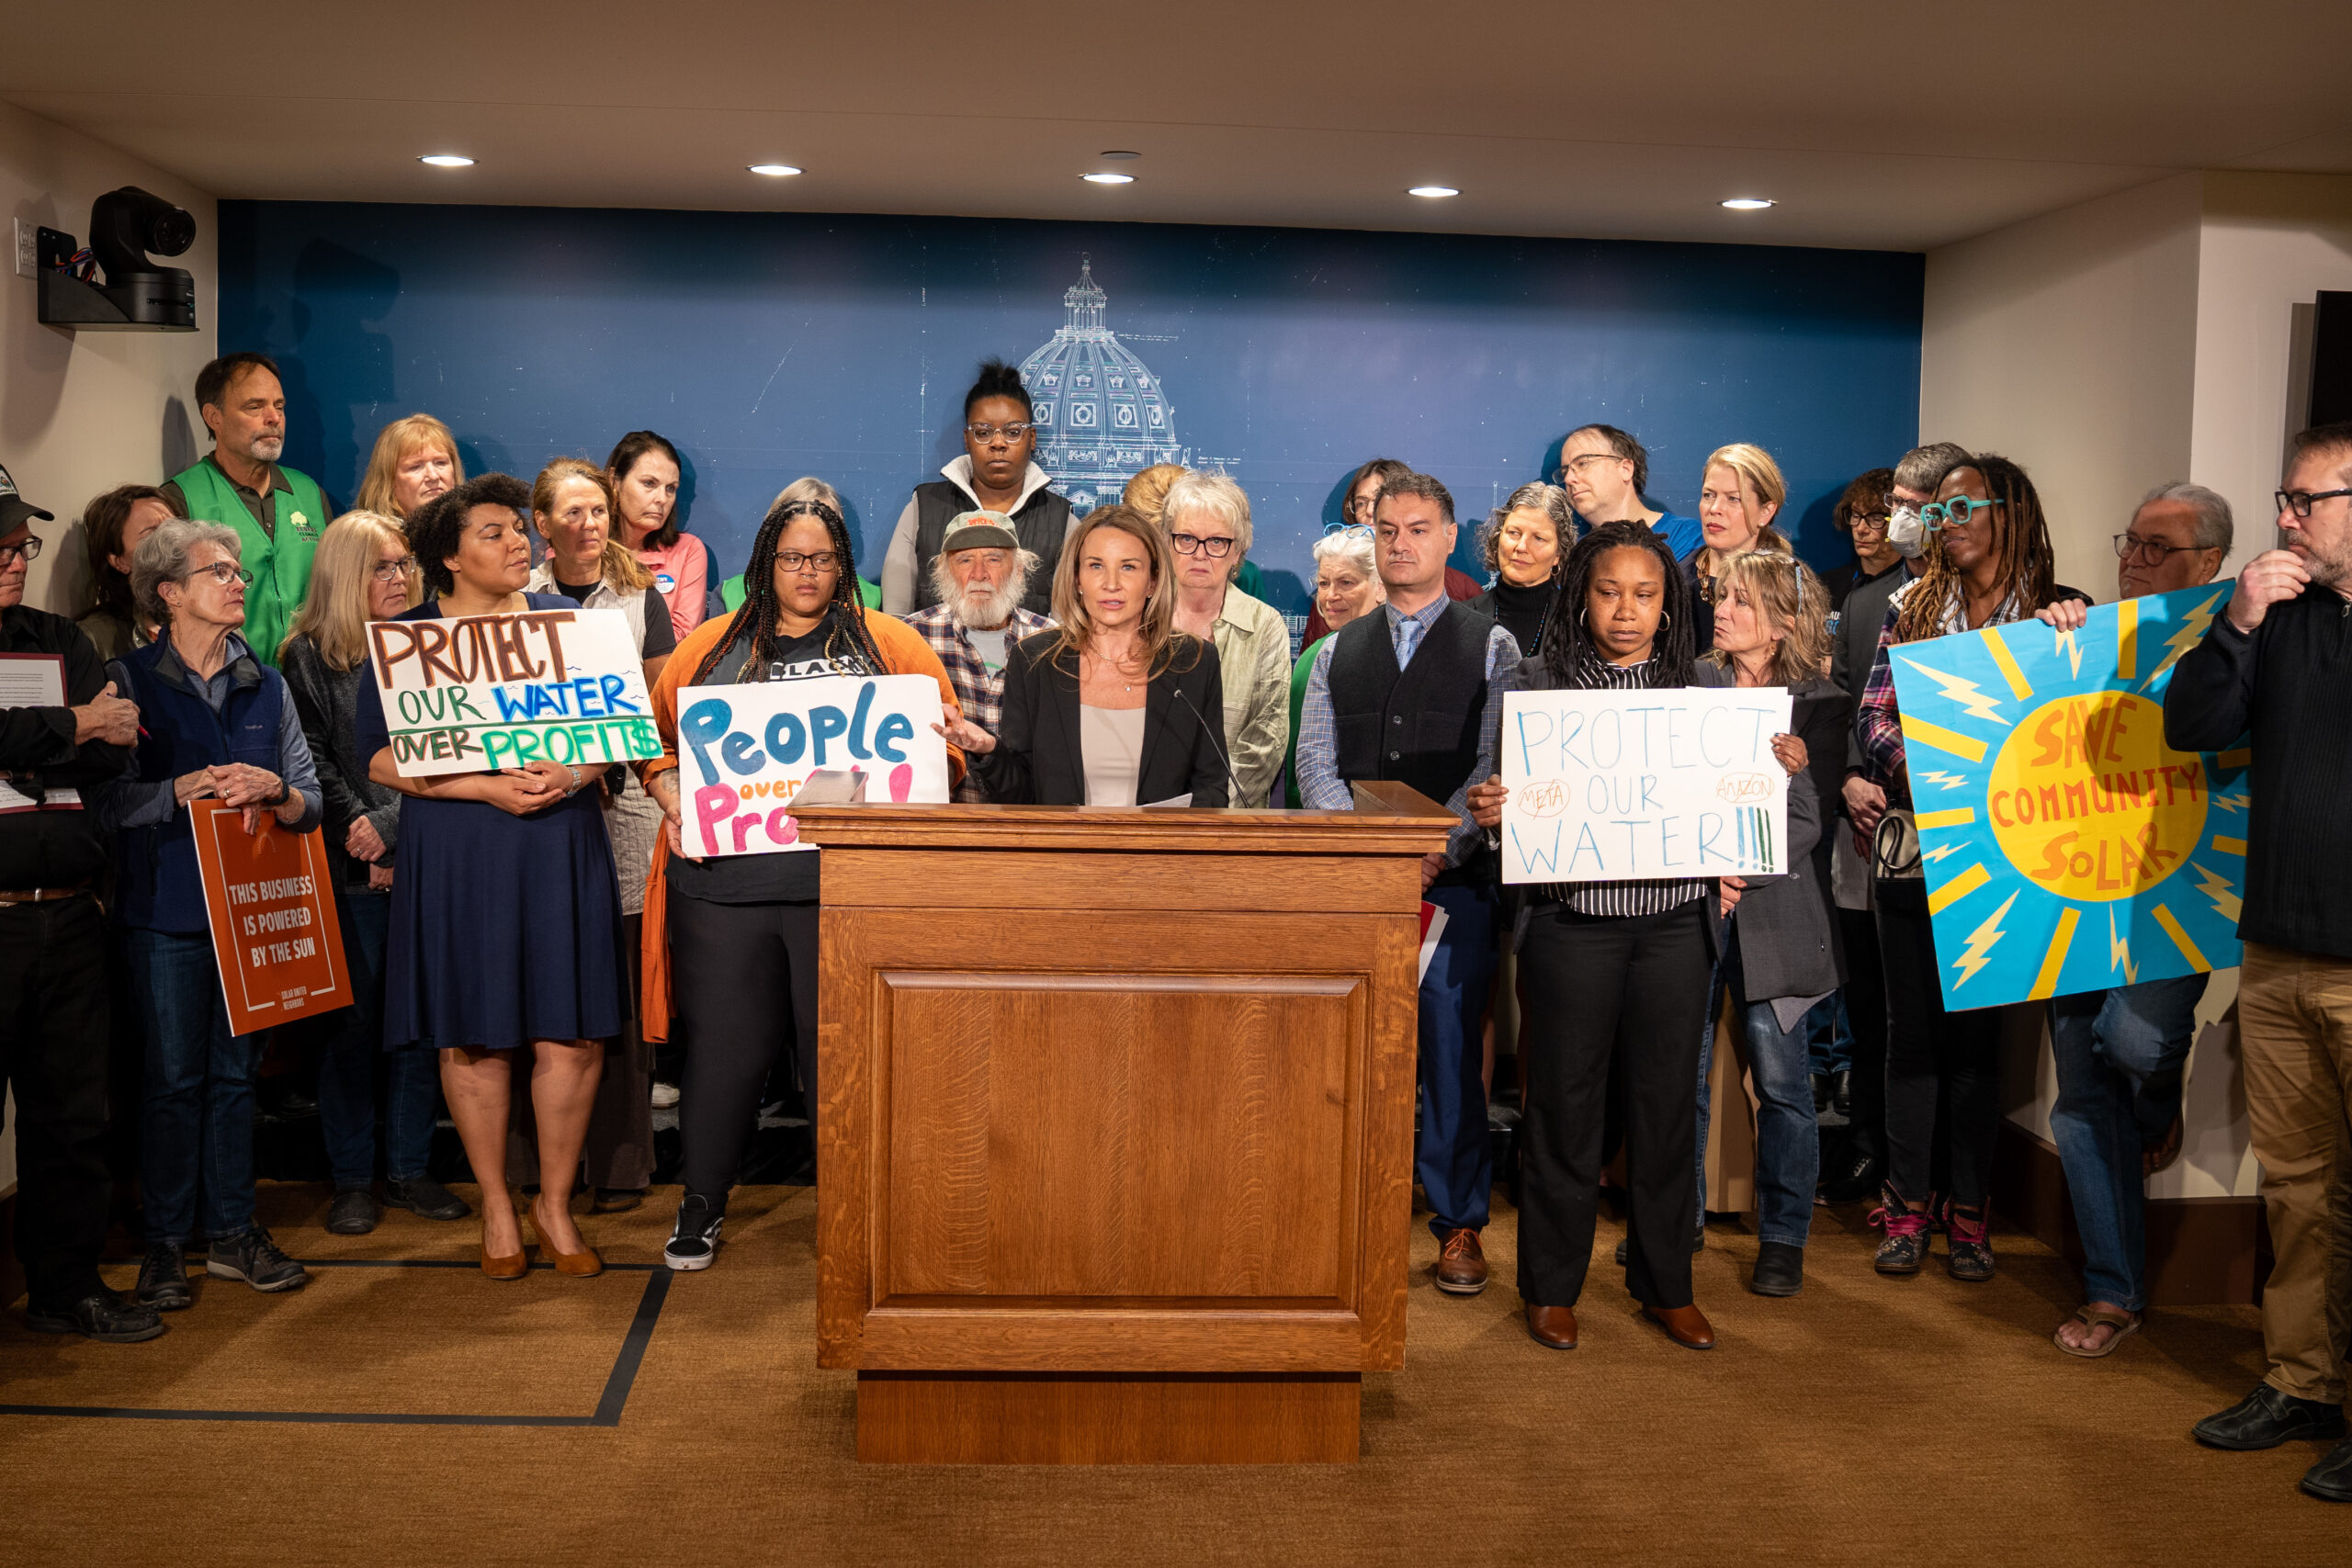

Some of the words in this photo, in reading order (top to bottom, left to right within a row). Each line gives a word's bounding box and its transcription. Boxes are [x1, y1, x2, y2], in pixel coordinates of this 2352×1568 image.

[371, 612, 576, 689] PROTECT
[398, 685, 487, 724] OUR
[491, 674, 641, 722] WATER
[392, 728, 483, 764] OVER
[1517, 706, 1776, 776] PROTECT
[2030, 696, 2138, 769] SAVE
[740, 779, 801, 799] over
[1521, 781, 1564, 810] META
[1589, 774, 1664, 814] OUR
[1715, 778, 1772, 796] AMAZON
[1991, 762, 2198, 829] COMMUNITY
[229, 882, 258, 905] THIS
[259, 875, 313, 902] BUSINESS
[243, 914, 256, 936] IS
[258, 907, 311, 933] POWERED
[251, 945, 268, 967] BY
[268, 941, 292, 964] THE
[292, 936, 316, 959] SUN
